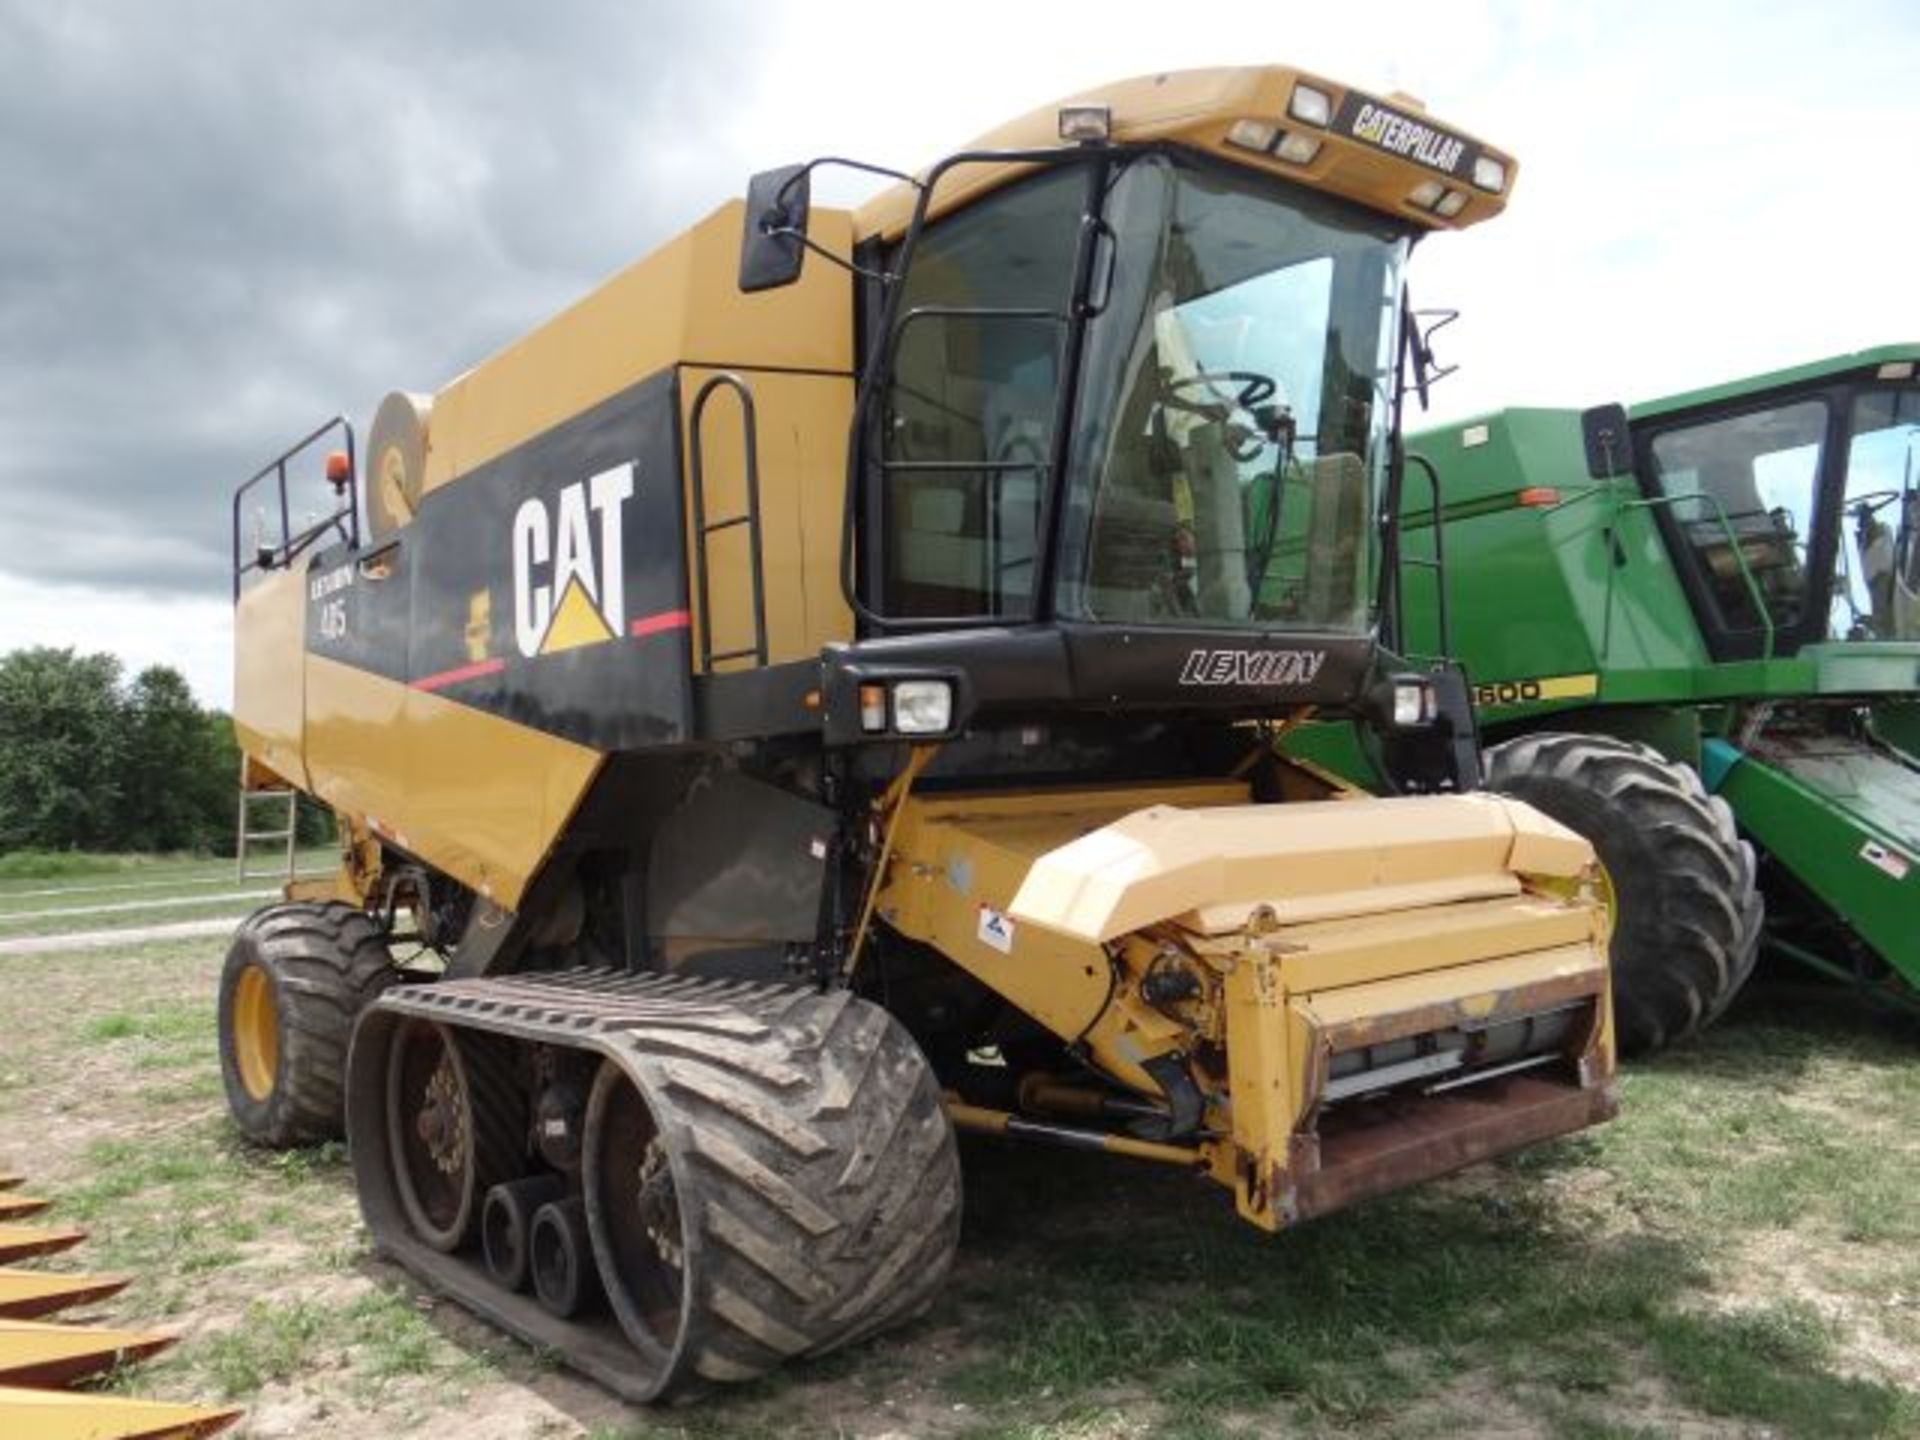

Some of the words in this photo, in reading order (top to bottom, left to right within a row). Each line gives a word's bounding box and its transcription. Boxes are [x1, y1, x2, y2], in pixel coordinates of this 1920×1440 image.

[1352, 104, 1465, 171] CATERPILLAR
[513, 461, 634, 658] CAT
[1179, 650, 1325, 685] LEXION
[1469, 682, 1541, 705] 600
